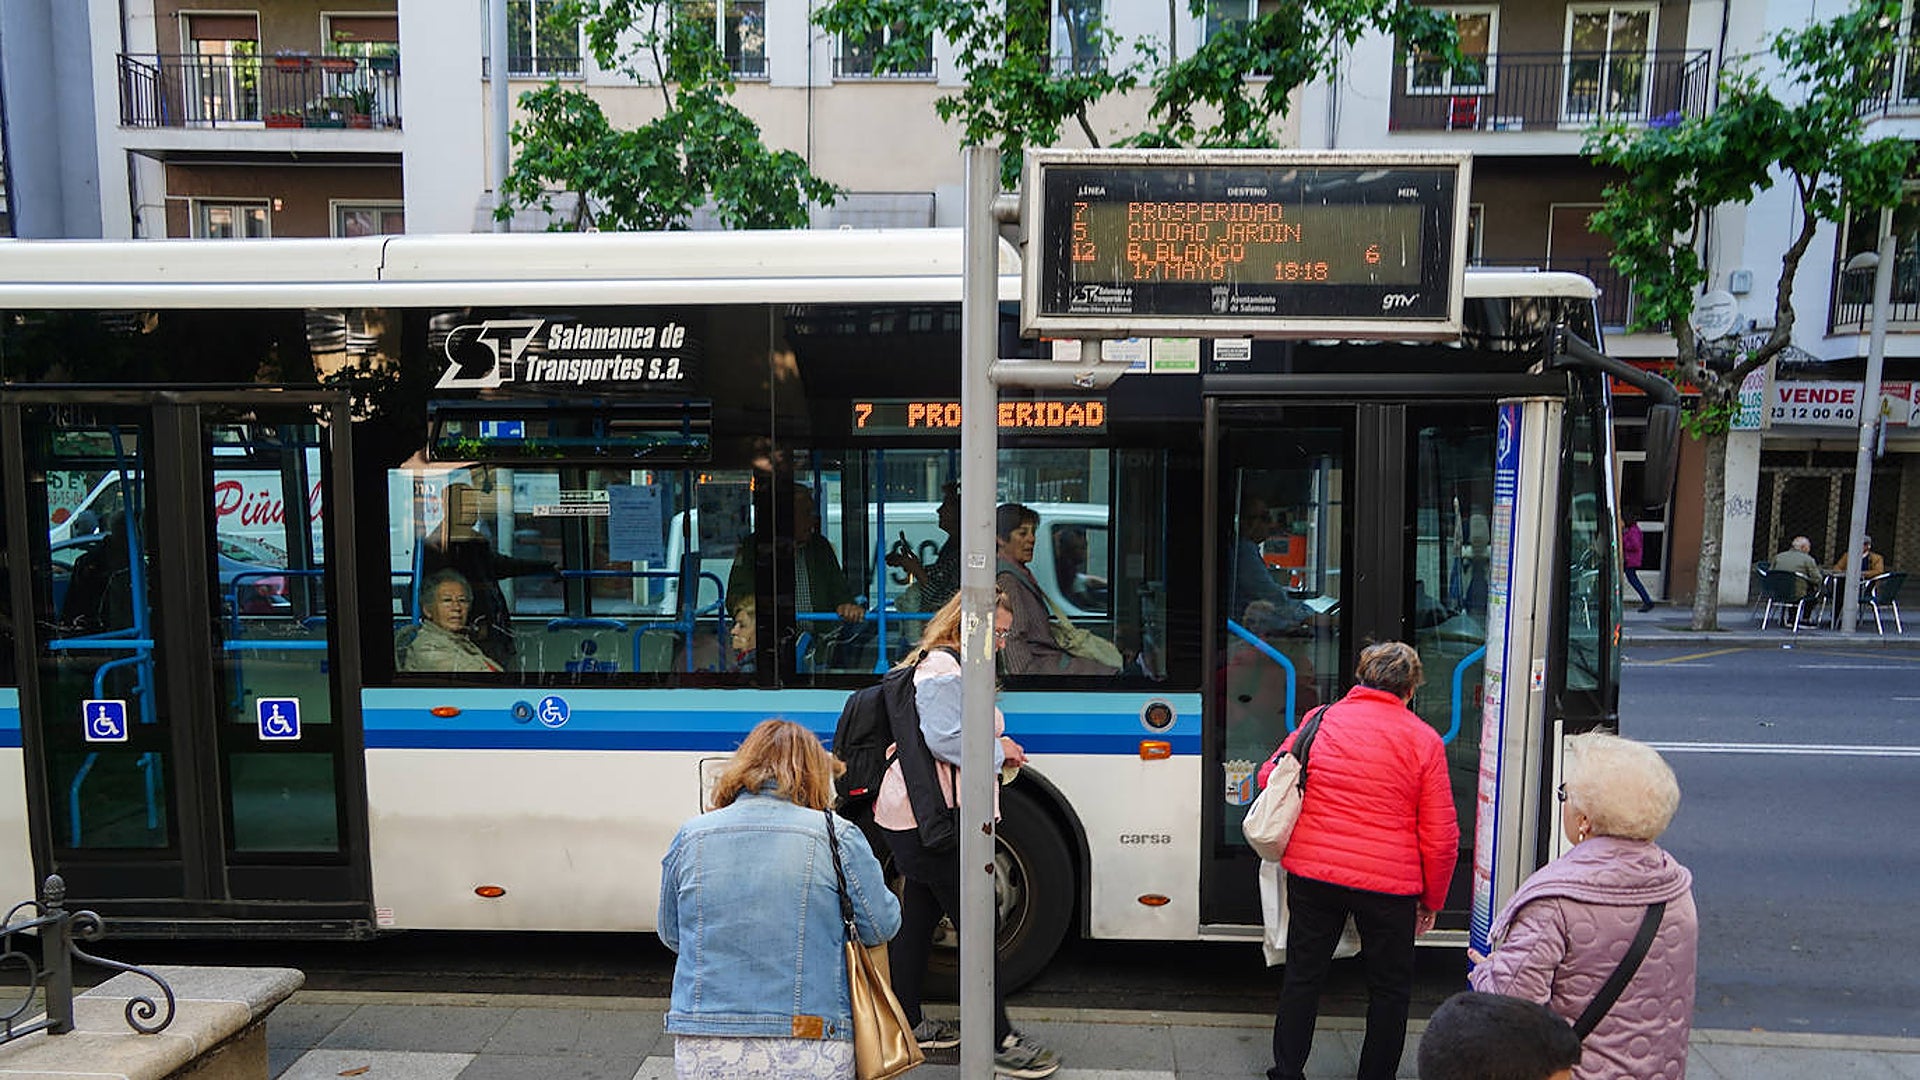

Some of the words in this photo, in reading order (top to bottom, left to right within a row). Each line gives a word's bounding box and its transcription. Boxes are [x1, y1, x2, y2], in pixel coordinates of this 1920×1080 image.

[1227, 187, 1268, 197] DESTINO
[1398, 187, 1419, 197] MIN.
[1074, 202, 1088, 221] 7
[1128, 202, 1283, 221] PROSPERIDAD
[1073, 222, 1087, 241] 5
[1128, 222, 1209, 242] CIUDAD
[1216, 222, 1301, 243] JARDIN
[1072, 242, 1096, 261] 12
[1156, 242, 1245, 263] BLANCO
[1365, 244, 1379, 264] 6
[1133, 260, 1157, 280] 17
[1165, 260, 1224, 281] MAYO
[1274, 261, 1328, 281] 18:18
[548, 323, 655, 350] Salamanca
[660, 323, 686, 349] de
[525, 354, 644, 385] Transportes
[648, 357, 684, 380] s.a.
[1779, 388, 1855, 404] VENDE
[854, 403, 873, 429] 7
[907, 402, 1104, 429] PROERIDAD
[1791, 407, 1808, 418] 12
[1812, 408, 1830, 419] 00
[1835, 409, 1854, 420] 40
[1119, 833, 1172, 845] carsa
